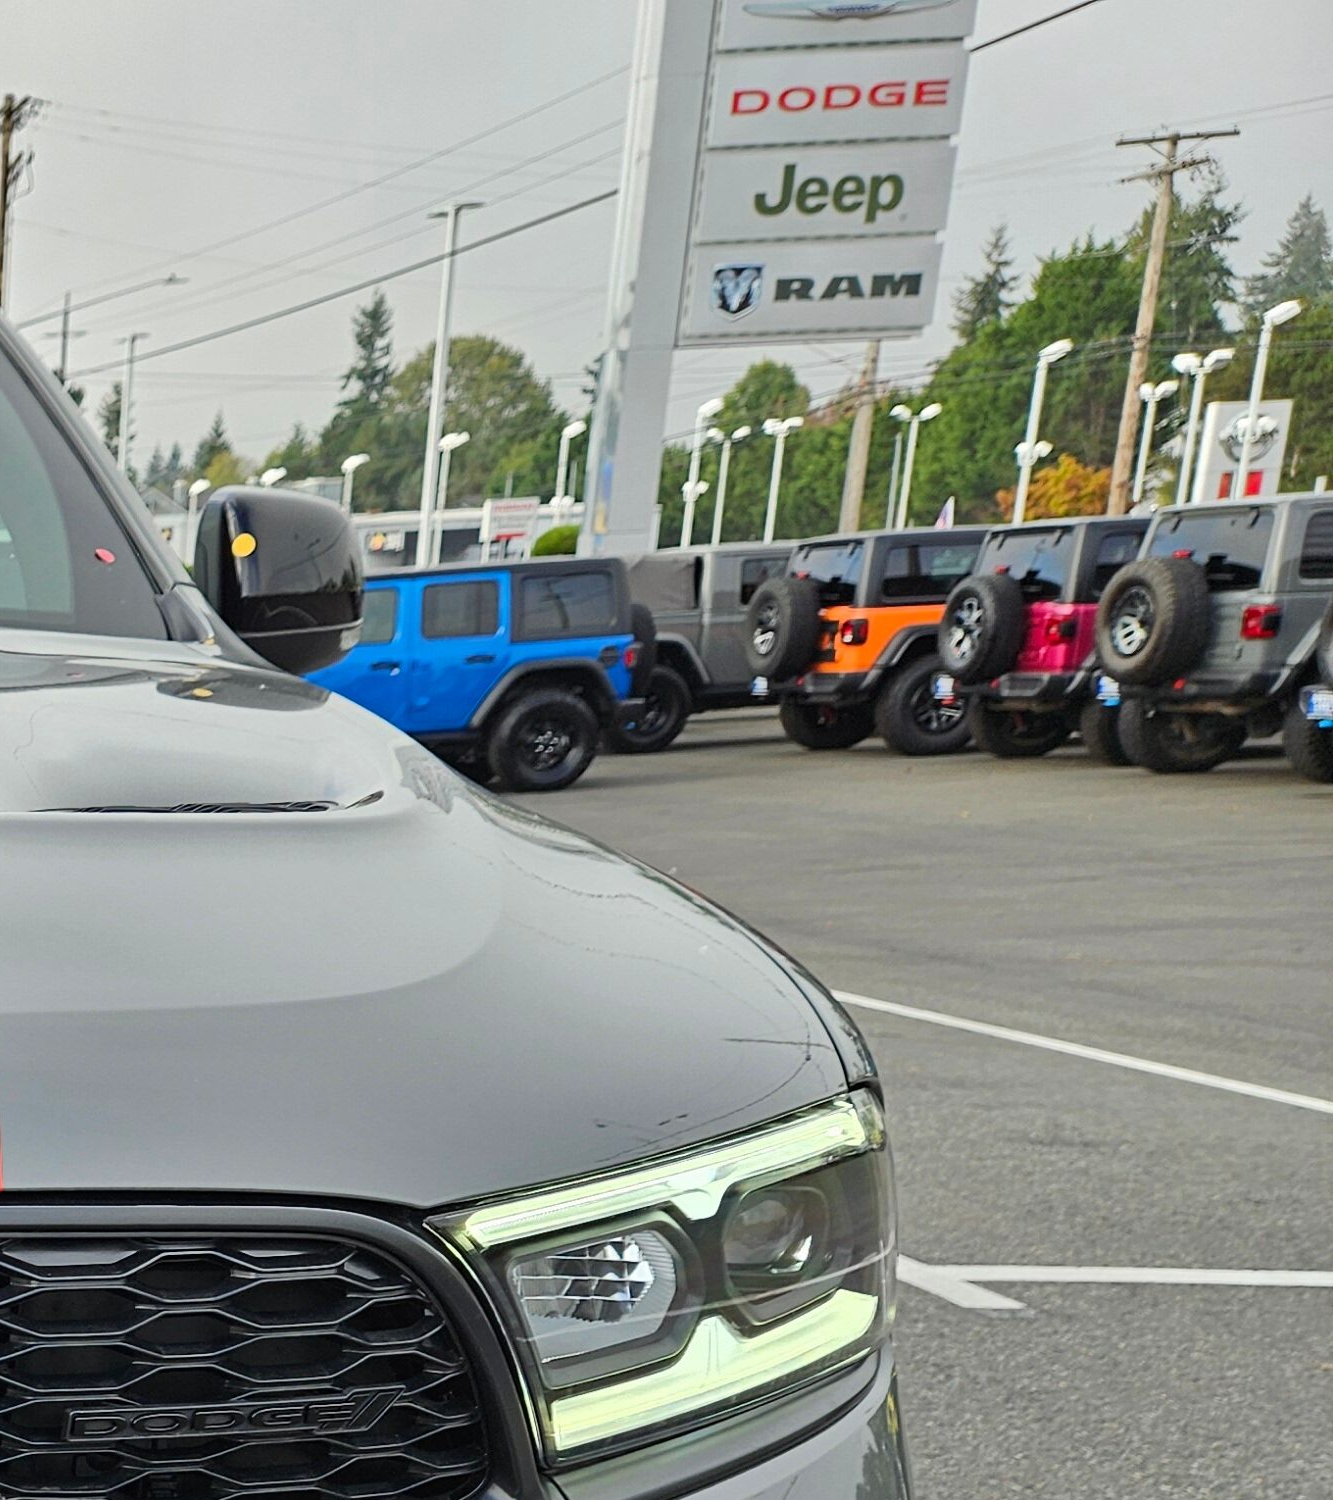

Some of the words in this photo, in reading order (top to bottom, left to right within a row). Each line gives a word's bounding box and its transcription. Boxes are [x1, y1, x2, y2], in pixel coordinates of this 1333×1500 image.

[731, 80, 949, 115] DODGE
[754, 163, 905, 223] Jeep
[774, 273, 924, 302] RAM
[72, 1401, 357, 1435] DODGE
